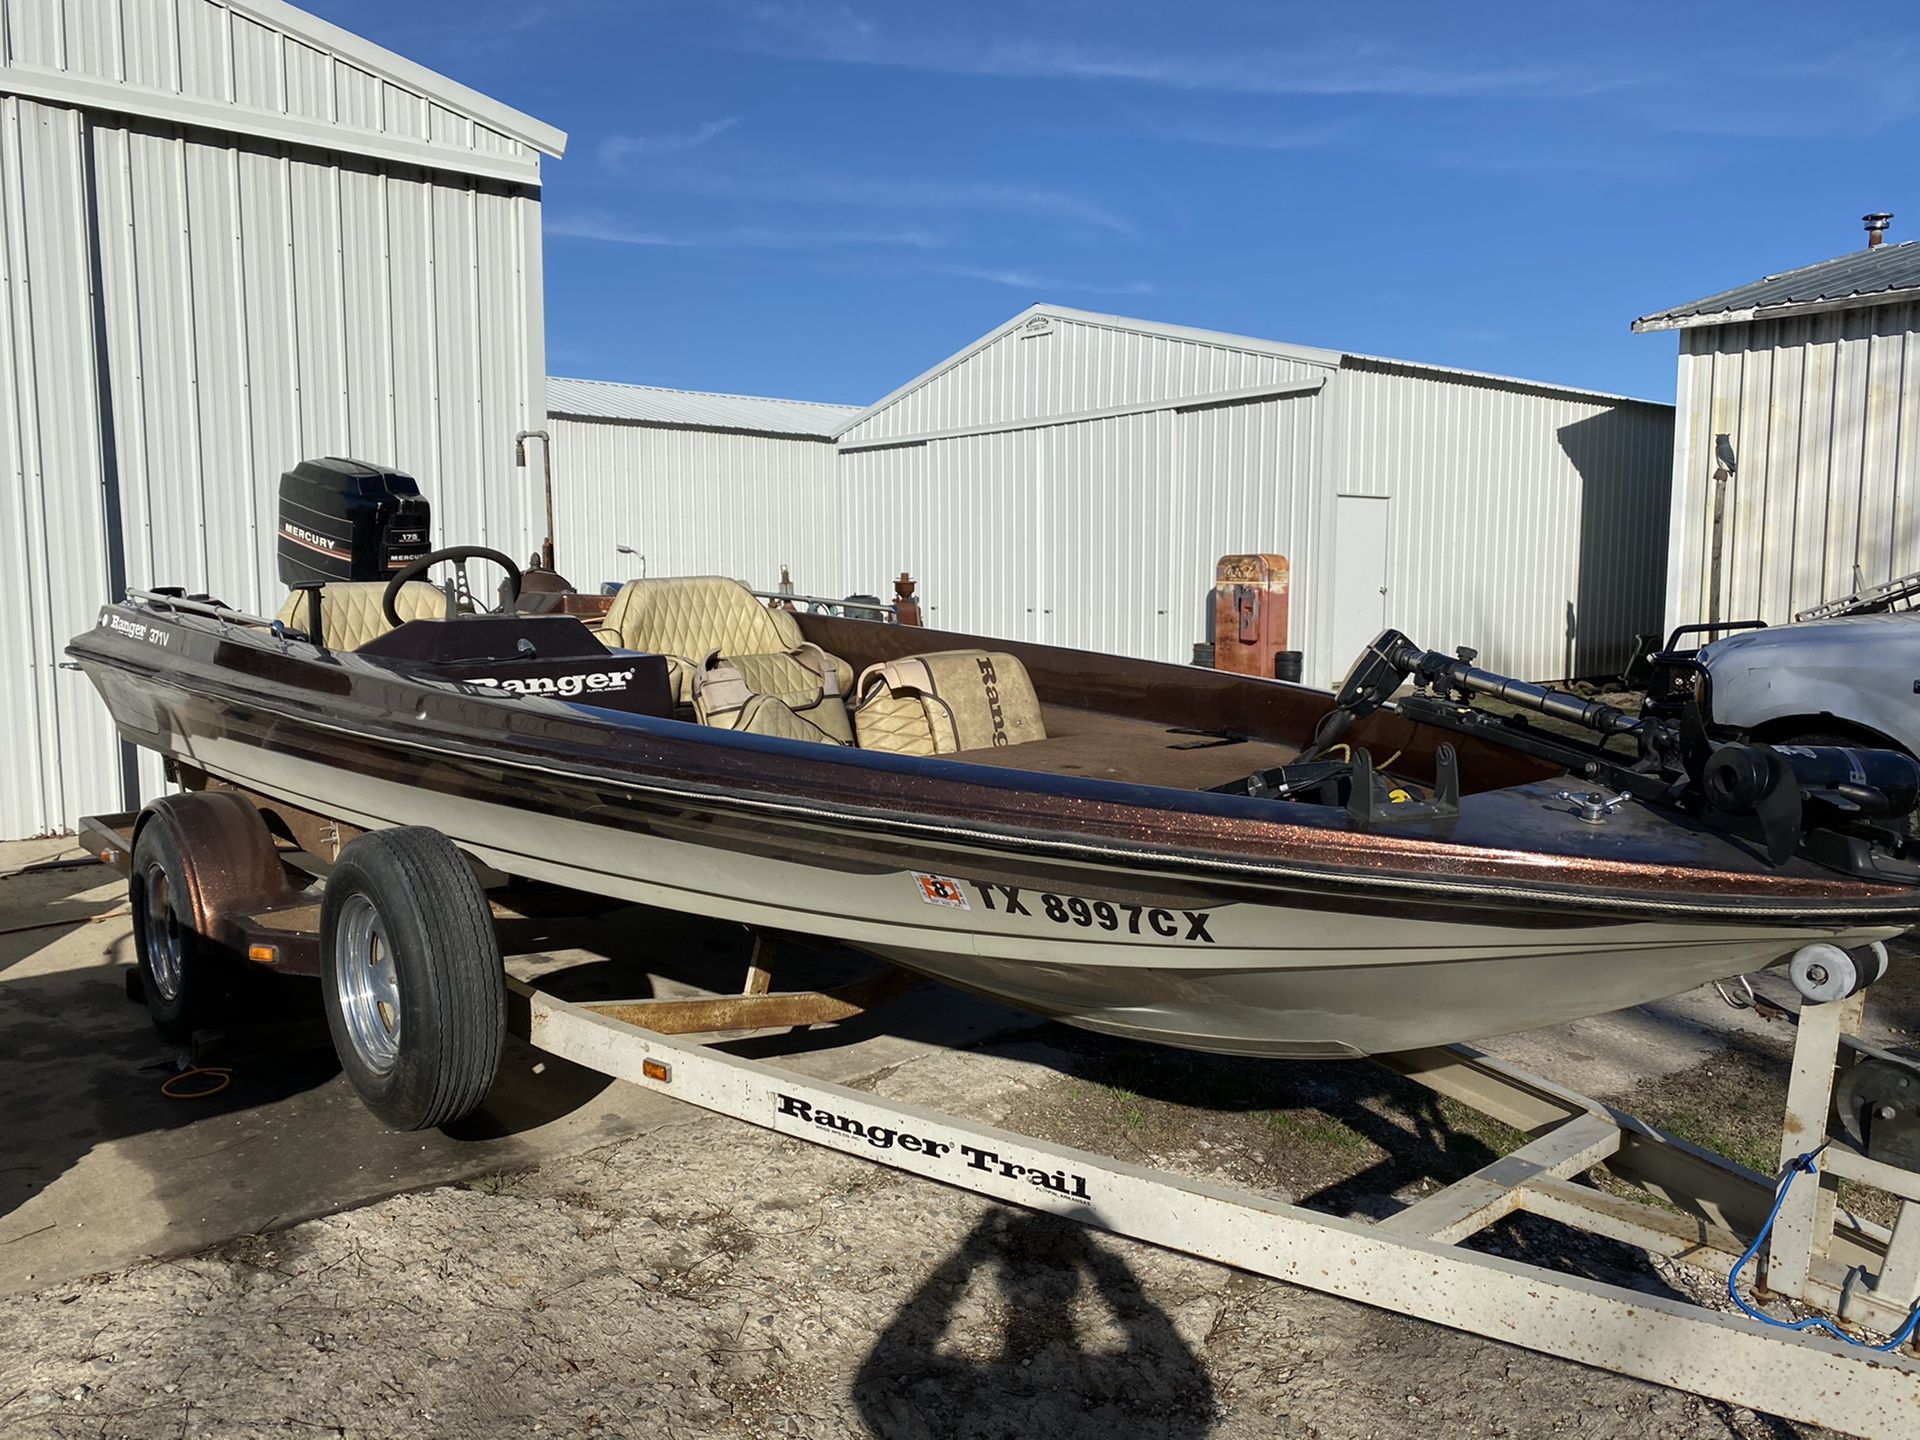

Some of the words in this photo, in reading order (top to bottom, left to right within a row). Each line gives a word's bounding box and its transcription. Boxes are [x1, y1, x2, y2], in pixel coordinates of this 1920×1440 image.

[285, 523, 335, 550] MERCURY
[390, 553, 427, 561] MERCU
[110, 614, 147, 638] Ranger
[149, 628, 170, 646] 371V
[968, 880, 1032, 917] TX
[1041, 893, 1216, 944] 8997CX
[777, 1093, 951, 1159] Ranger
[961, 1145, 1092, 1201] Trail
